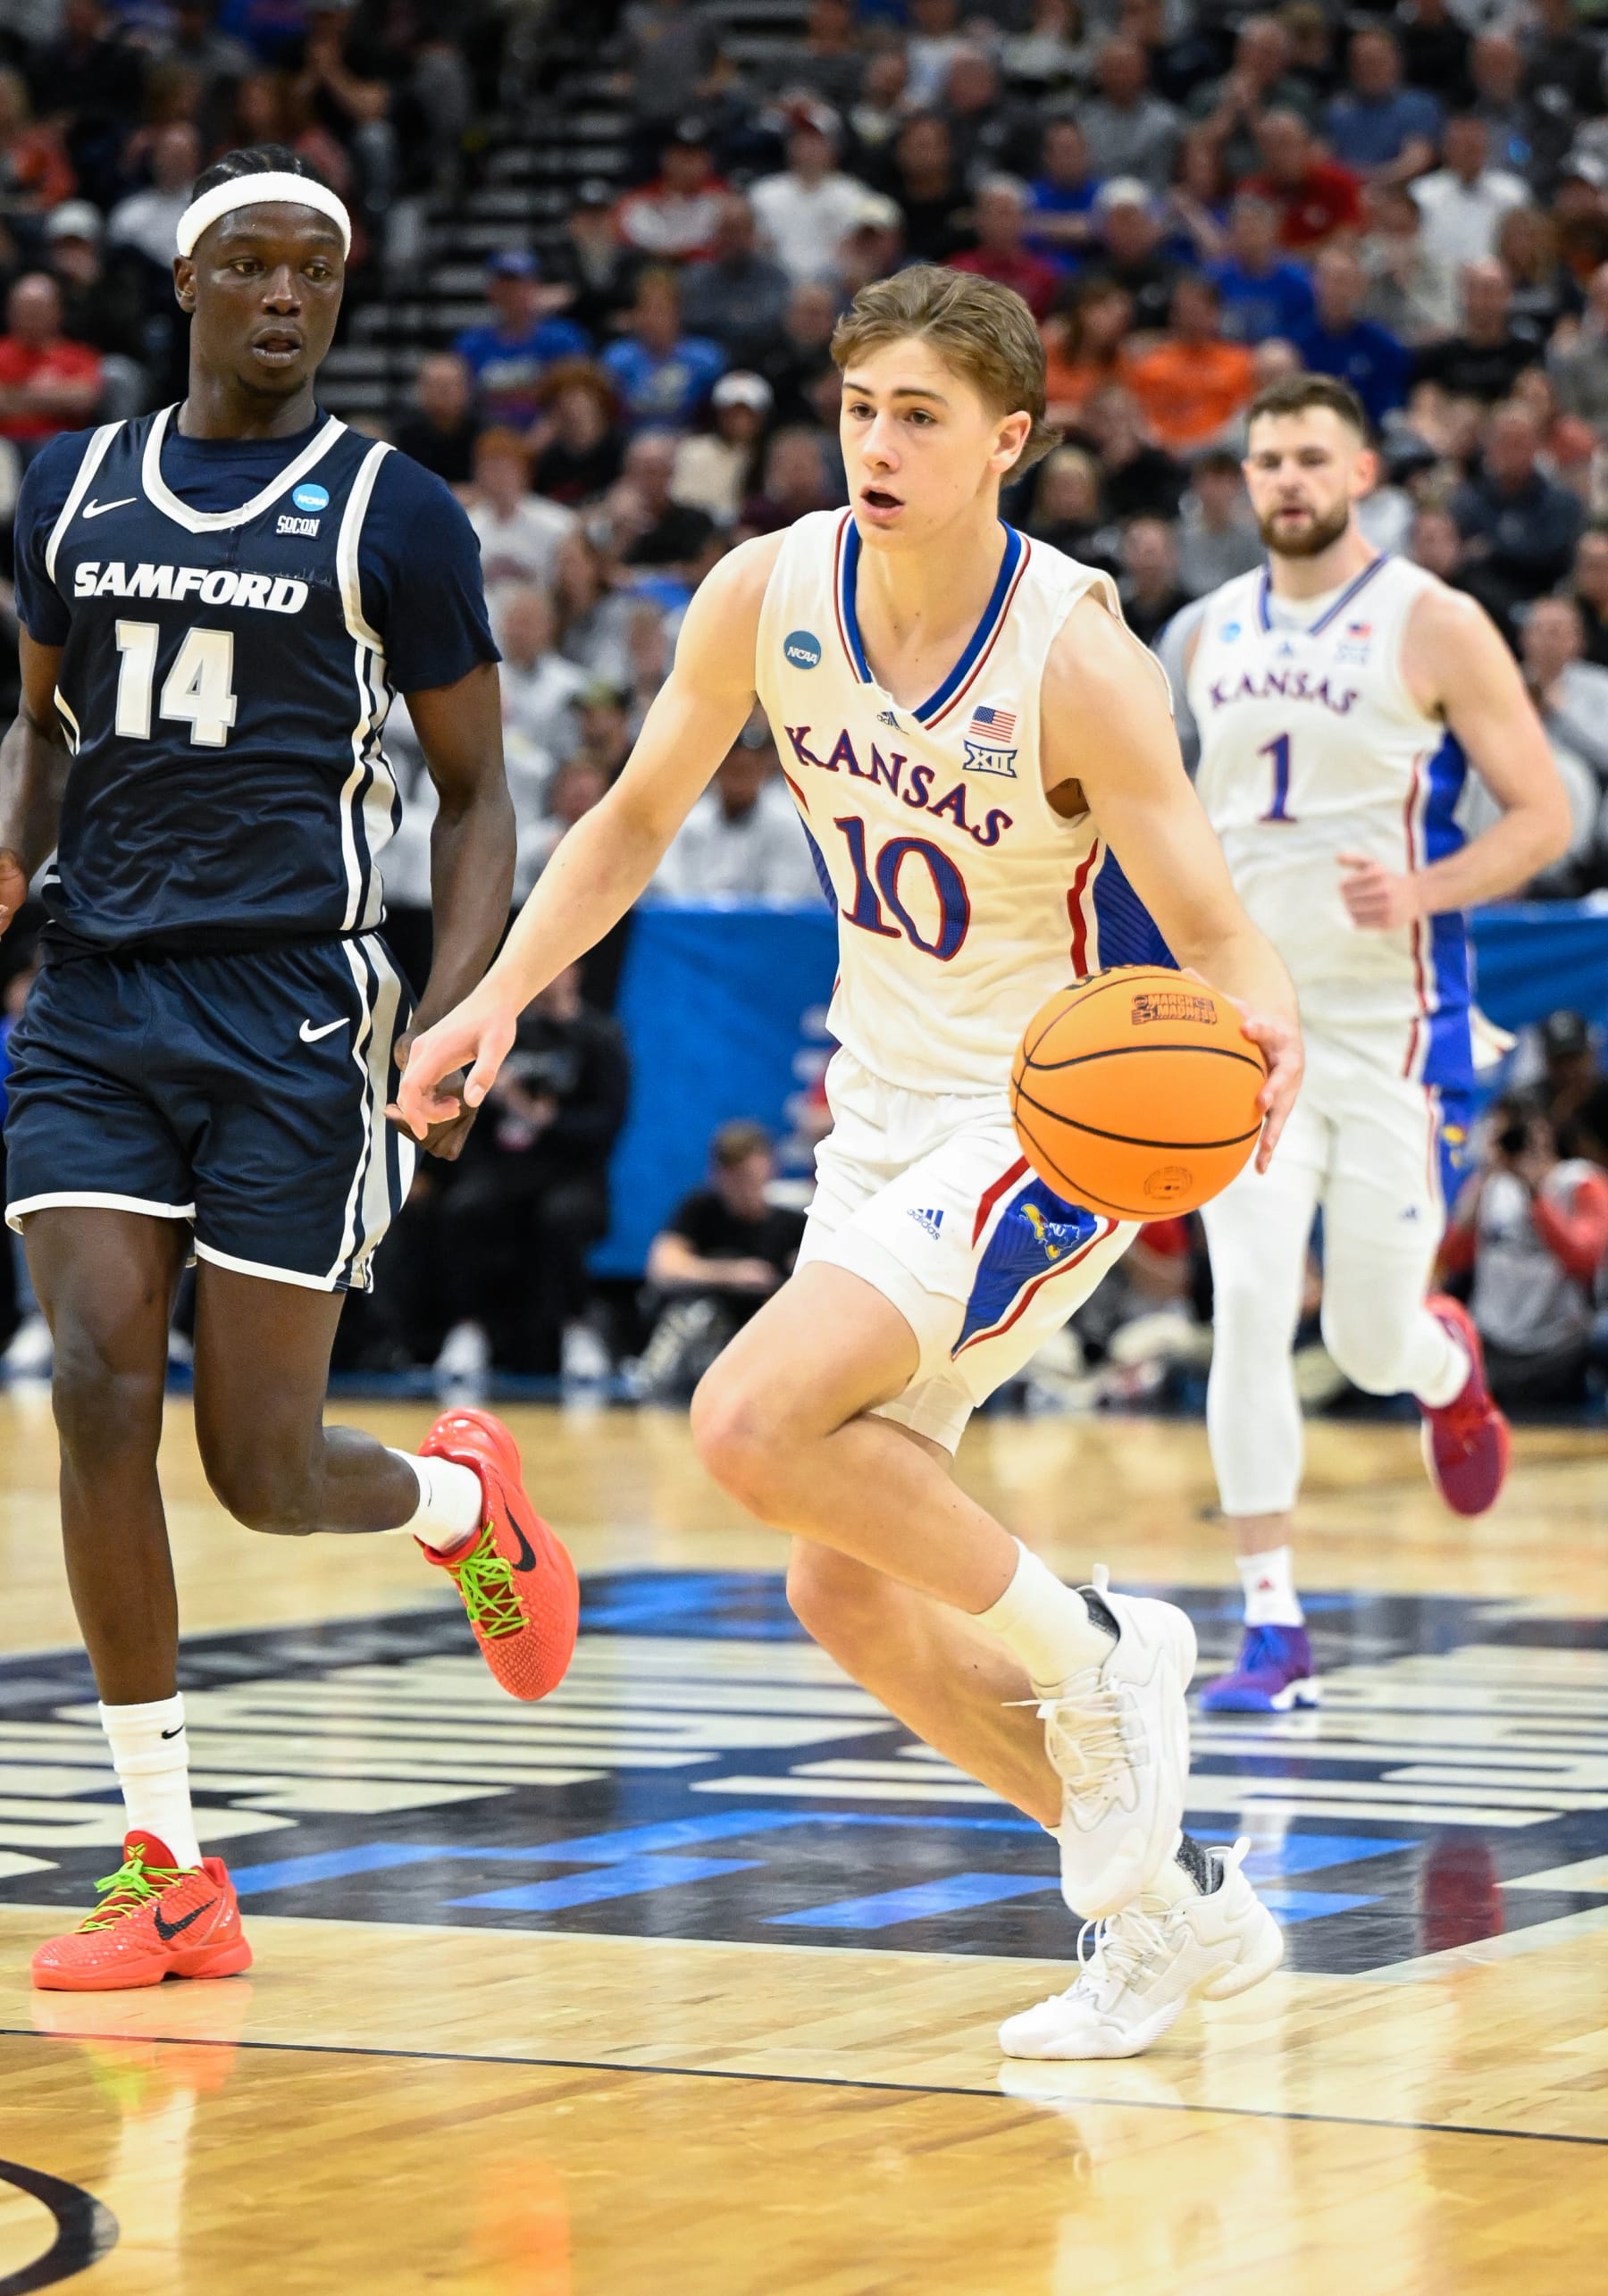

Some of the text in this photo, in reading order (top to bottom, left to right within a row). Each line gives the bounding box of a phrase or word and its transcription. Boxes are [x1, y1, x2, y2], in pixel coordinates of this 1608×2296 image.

[276, 515, 320, 536] SOCON
[74, 562, 309, 615] SAMFORD
[787, 646, 817, 665] NCAA
[115, 619, 238, 748] 14
[1209, 669, 1359, 716] KANSAS
[783, 725, 1013, 847] KANSAS
[1256, 730, 1298, 825] 1
[833, 815, 971, 962] 10
[1147, 993, 1193, 1007] MARCH
[1157, 1004, 1217, 1022] MADNESS
[907, 1208, 941, 1241] adidas
